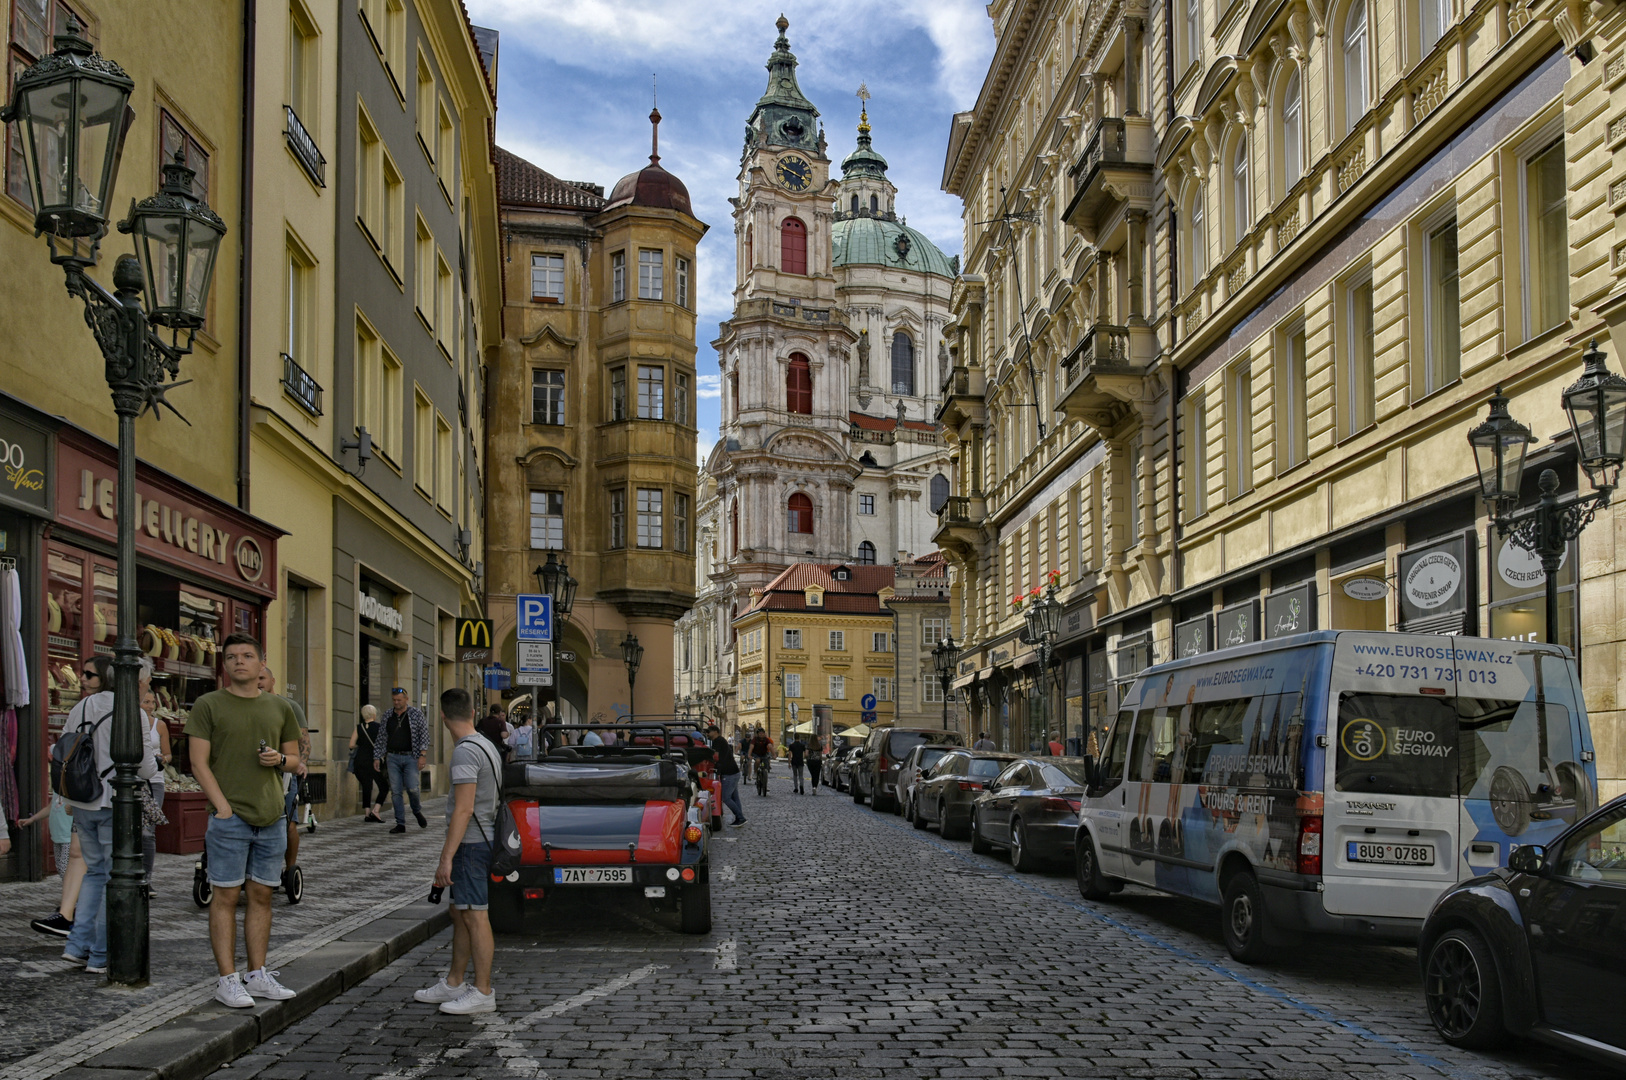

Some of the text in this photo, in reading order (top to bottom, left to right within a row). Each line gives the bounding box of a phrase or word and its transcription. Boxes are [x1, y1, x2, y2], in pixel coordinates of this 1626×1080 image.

[1408, 555, 1458, 584] ORIGINAL CZECH GIFTS
[1505, 568, 1526, 581] CZECH
[1411, 580, 1452, 600] SOUVENIR SHOP
[524, 600, 544, 626] P
[520, 627, 549, 636] RÉSERVÉ
[485, 669, 511, 677] SOUVENIRS
[1355, 663, 1497, 684] +420 731 731 013
[1395, 729, 1435, 743] EURO
[1393, 743, 1453, 757] SEGWAY
[1209, 754, 1292, 774] PRAGUE SEGWAY
[1207, 792, 1275, 815] TOURS & RENT
[1346, 801, 1396, 810] TRANSIT
[1360, 845, 1384, 859] 8U9
[1395, 847, 1427, 861] 0788
[564, 869, 587, 881] 7AY
[596, 869, 627, 881] 7595
